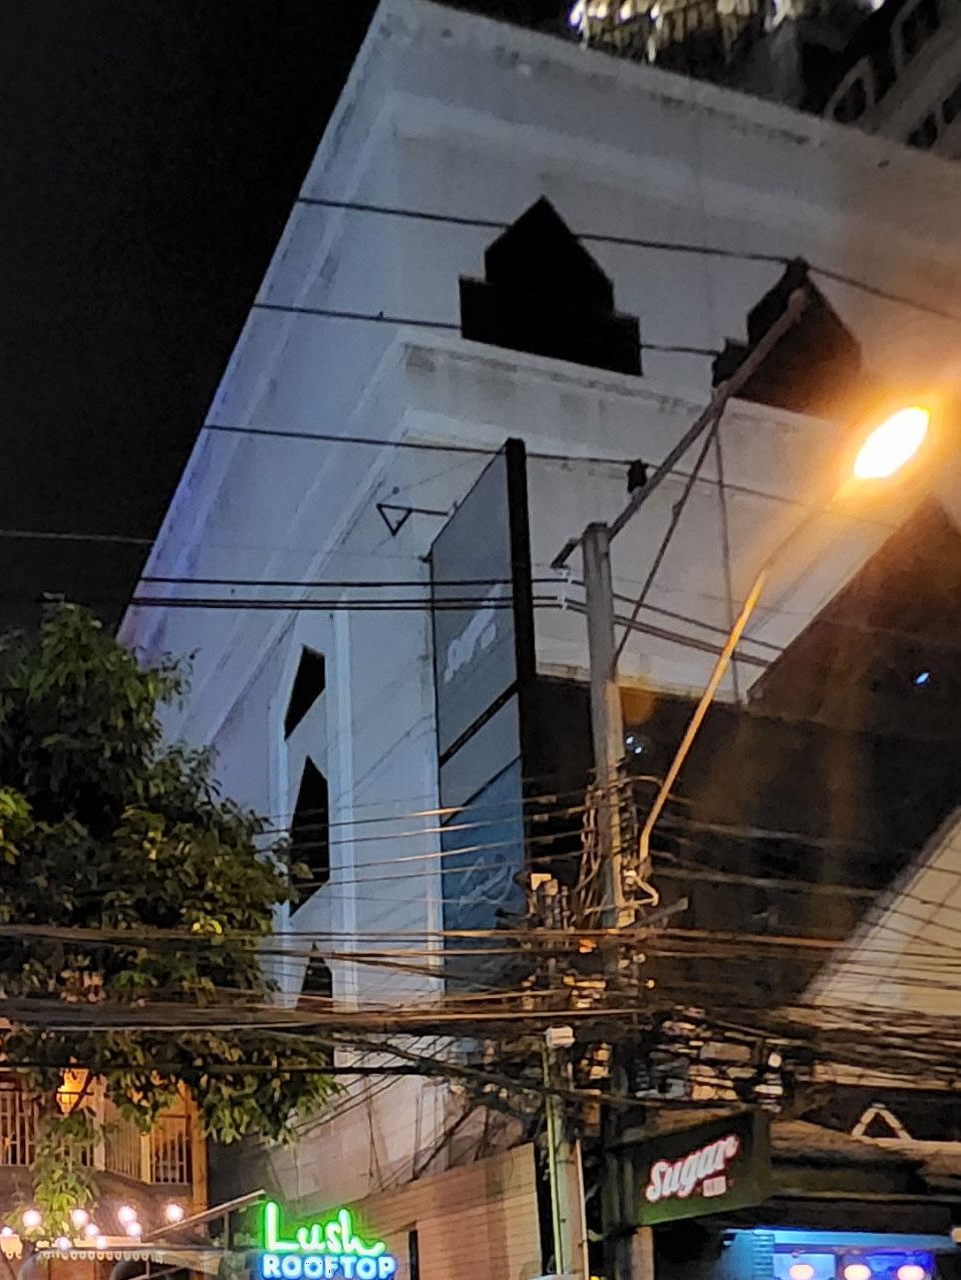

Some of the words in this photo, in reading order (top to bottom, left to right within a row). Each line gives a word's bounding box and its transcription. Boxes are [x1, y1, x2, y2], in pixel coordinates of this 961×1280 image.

[645, 1135, 738, 1202] Sugar
[264, 1201, 386, 1257] Lush
[262, 1254, 395, 1280] ROOFTOP
